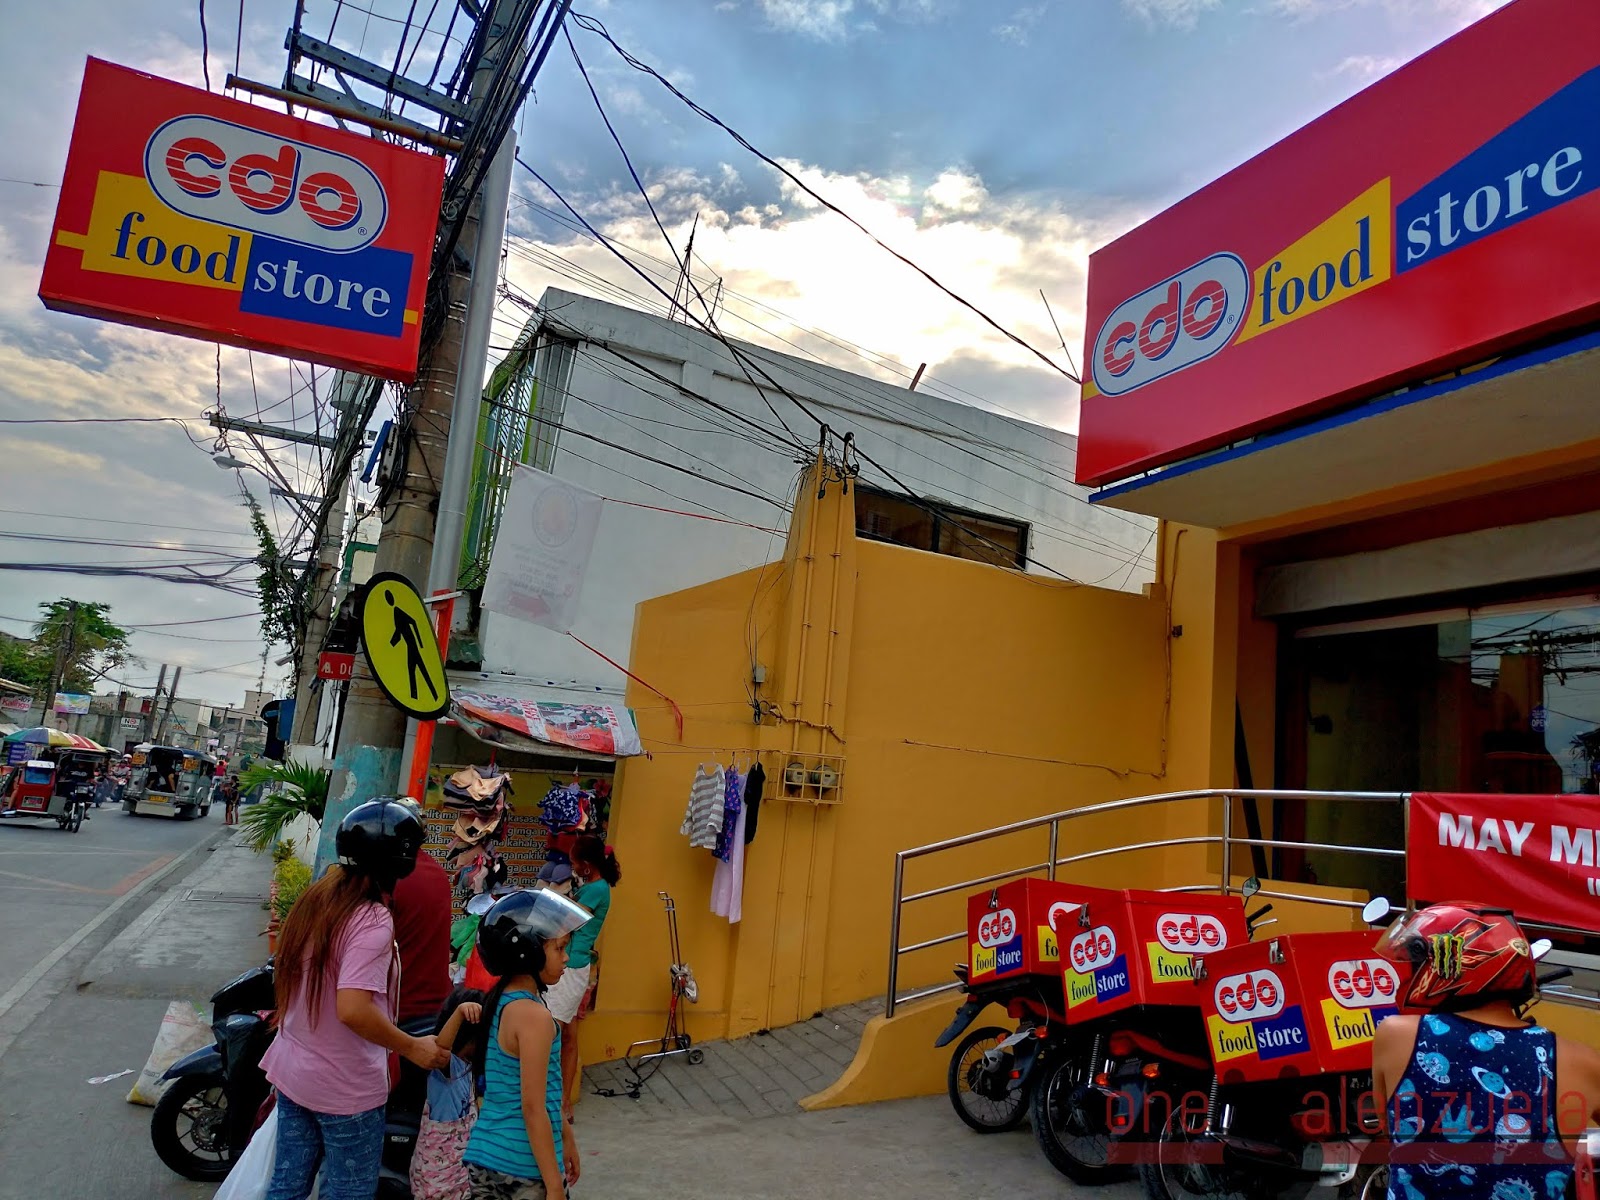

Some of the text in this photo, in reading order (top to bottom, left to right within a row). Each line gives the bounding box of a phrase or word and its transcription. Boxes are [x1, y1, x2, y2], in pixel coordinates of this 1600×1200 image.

[166, 137, 362, 232] cdo
[110, 211, 391, 318] food store
[1103, 146, 1583, 378] cdo food store
[1438, 811, 1535, 857] MAY
[981, 912, 1012, 942] cdo
[1162, 916, 1220, 947] cdo
[976, 950, 1021, 971] food store
[1045, 938, 1058, 957] fo
[1073, 931, 1111, 966] cdo
[1157, 956, 1193, 977] food
[1334, 961, 1395, 999] cdo
[1071, 972, 1126, 1001] food store
[1219, 974, 1278, 1014] cdo
[1218, 1025, 1303, 1054] food store
[1333, 1013, 1374, 1040] food
